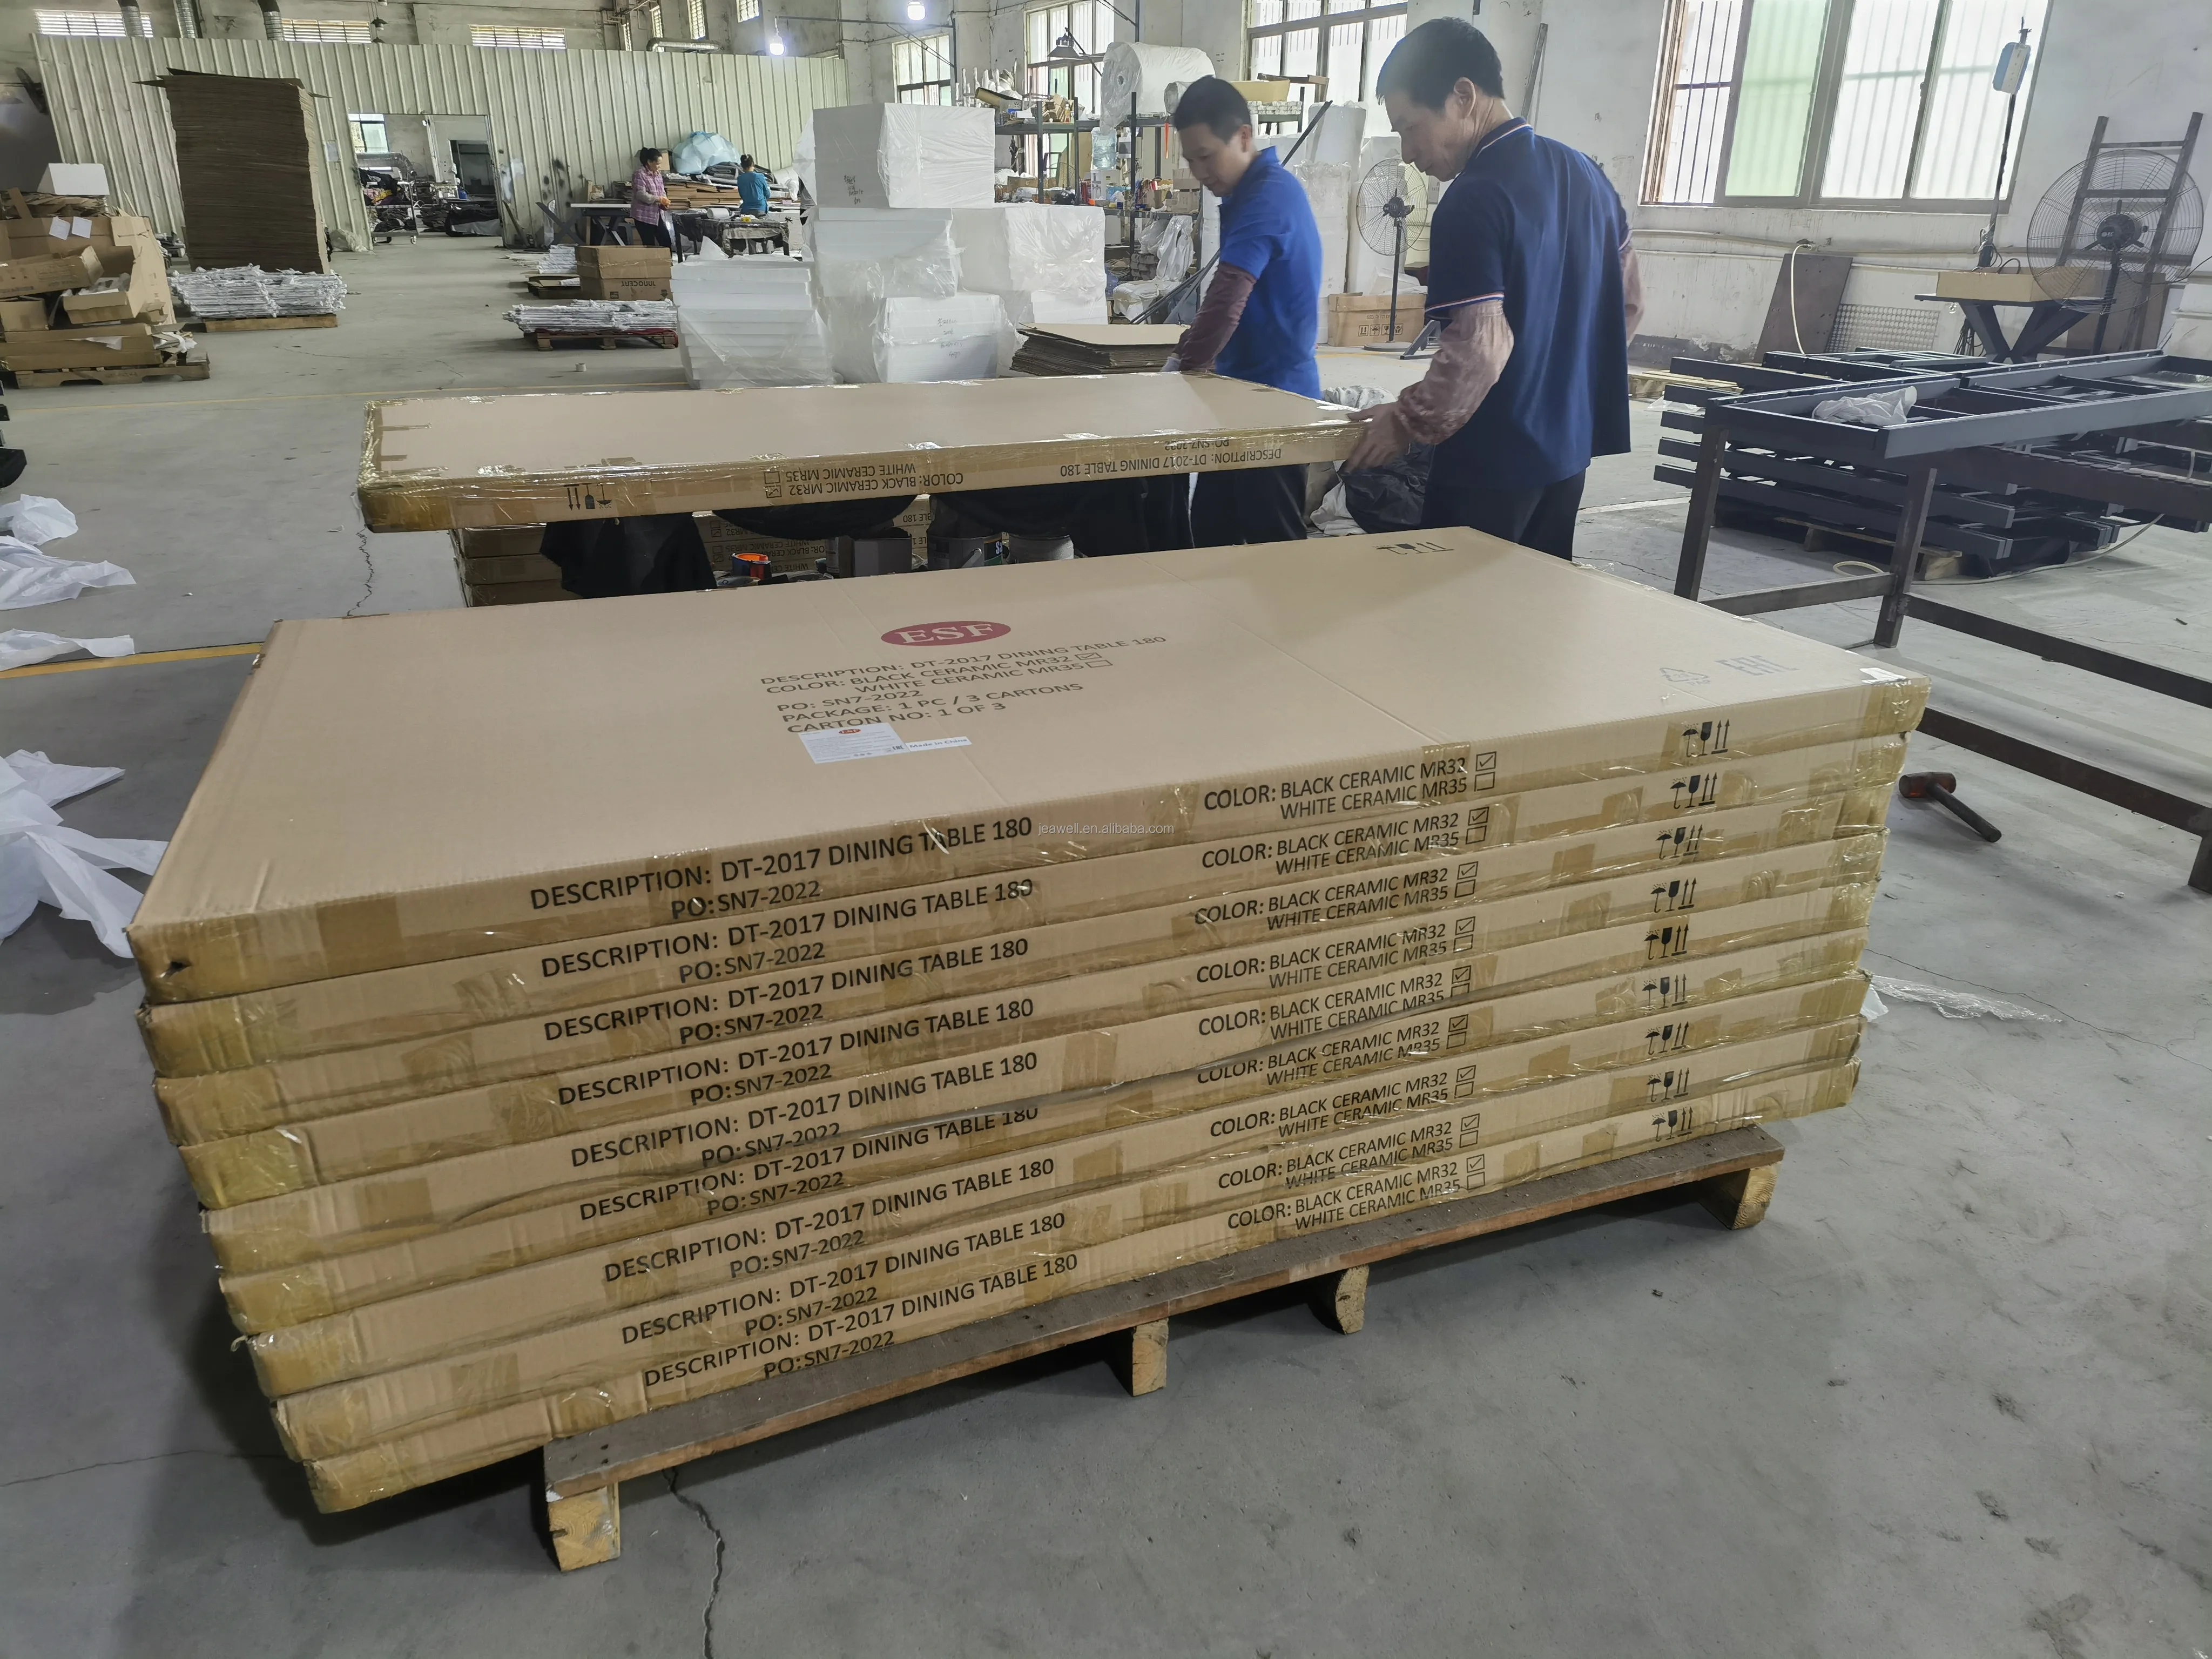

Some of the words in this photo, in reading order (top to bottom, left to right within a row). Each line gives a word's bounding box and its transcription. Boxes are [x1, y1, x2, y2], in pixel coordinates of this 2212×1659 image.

[786, 469, 819, 482] MR35
[823, 466, 875, 480] CERAMIC
[879, 463, 916, 475] WHITE
[1060, 463, 1081, 477] 180
[1084, 461, 1117, 475] TABLE
[1121, 457, 1159, 472] DINING
[1163, 454, 1206, 468] DT-2017
[1211, 448, 1281, 464] DESCRIPTION:
[790, 483, 822, 496] MR32
[826, 479, 878, 494] CERAMIC
[882, 476, 916, 489] BLACK
[919, 473, 963, 486] COLOR:
[903, 515, 917, 523] 180
[919, 512, 932, 521] BLE
[750, 542, 783, 550] CERAMIC
[894, 623, 994, 644] ESF
[761, 665, 903, 684] DESCRIPTION:
[910, 655, 992, 669] DT-2017
[997, 648, 1069, 660] DINING
[1070, 640, 1129, 651] TABLE
[1131, 637, 1166, 645] 180
[766, 680, 845, 693] COLOR:
[850, 672, 915, 686] BLACK
[920, 663, 1011, 677] CERAMIC
[1015, 656, 1073, 667] MR32
[854, 679, 926, 693] WHITE
[931, 670, 1024, 685] CERAMIC
[1027, 663, 1084, 675] MR35
[777, 702, 816, 712] PO:
[822, 690, 923, 707] SN7-2022
[782, 705, 890, 723] PACKAGE:
[918, 698, 947, 707] PC
[953, 696, 959, 705] /
[986, 684, 1084, 699] CARTONS
[787, 716, 883, 733] CARTON
[889, 711, 932, 722] NO:
[938, 709, 952, 717] 1
[957, 705, 986, 714] OF
[993, 703, 1007, 711] 3
[1204, 785, 1276, 810] COLOR:
[1281, 776, 1334, 799] BLACK
[1339, 765, 1414, 790] CERAMIC
[1420, 757, 1466, 779] MR32
[1280, 797, 1336, 820] WHITE
[1342, 785, 1417, 811] CERAMIC
[1421, 777, 1467, 799] MR35
[1202, 843, 1272, 868] COLOR:
[1277, 833, 1329, 855] BLACK
[1334, 820, 1408, 846] CERAMIC
[1413, 813, 1458, 834] MR32
[1276, 852, 1330, 875] WHITE
[1336, 839, 1408, 865] CERAMIC
[531, 866, 711, 909] DESCRIPTION:
[721, 848, 820, 882] DT-2017
[829, 834, 912, 865] DINING
[919, 824, 986, 851] TABLE
[993, 817, 1031, 840] 180
[672, 880, 820, 919] PO:SN7-2022
[1267, 908, 1321, 930] WHITE
[1326, 894, 1399, 919] CERAMIC
[1404, 885, 1448, 907] MR35
[1269, 889, 1319, 912] BLACK
[1325, 876, 1399, 901] CERAMIC
[1403, 867, 1448, 889] MR32
[542, 932, 717, 977] DESCRIPTION:
[729, 913, 825, 946] DT-2017
[834, 899, 916, 928] DINING
[922, 887, 988, 913] TABLE
[680, 942, 825, 983] PO:SN7-2022
[1197, 957, 1265, 983] COLOR:
[1270, 948, 1320, 970] BLACK
[1325, 933, 1397, 959] CERAMIC
[1269, 966, 1322, 989] WHITE
[1327, 951, 1398, 977] CERAMIC
[1404, 941, 1447, 962] MR35
[544, 995, 718, 1041] DESCRIPTION:
[729, 975, 824, 1008] DT-2017
[832, 959, 912, 989] DINING
[919, 947, 983, 973] TABLE
[990, 938, 1028, 960] 180
[1199, 1009, 1266, 1035] COLOR:
[1270, 999, 1320, 1021] BLACK
[1325, 982, 1395, 1009] CERAMIC
[1400, 973, 1442, 994] MR32
[680, 1003, 823, 1044] PO:SN7-2022
[558, 1057, 729, 1105] DESCRIPTION:
[738, 1036, 832, 1069] DT-2017
[840, 1020, 919, 1050] DINING
[925, 1007, 989, 1033] TABLE
[996, 999, 1034, 1022] 180
[1267, 1047, 1317, 1069] BLACK
[1322, 1031, 1392, 1057] CERAMIC
[1397, 1022, 1439, 1042] MR32
[691, 1064, 832, 1105] PO:SN7-2022
[1210, 1111, 1275, 1137] COLOR:
[1279, 1099, 1327, 1121] BLACK
[1332, 1082, 1401, 1109] CERAMIC
[1405, 1072, 1448, 1094] MR32
[571, 1116, 739, 1167] DESCRIPTION:
[748, 1094, 840, 1129] DT-2017
[848, 1076, 926, 1108] DINING
[931, 1061, 994, 1090] TABLE
[1000, 1052, 1037, 1076] 180
[580, 1170, 744, 1220] DESCRIPTION:
[754, 1146, 845, 1181] DT-2017
[853, 1129, 929, 1159] DINING
[934, 1114, 995, 1140] TABLE
[1218, 1162, 1283, 1189] COLOR:
[1286, 1150, 1334, 1173] BLACK
[1339, 1132, 1406, 1160] CERAMIC
[1410, 1121, 1452, 1143] MR32
[707, 1171, 844, 1216] PO:SN7-2022
[775, 1203, 865, 1239] DT-2017
[873, 1184, 947, 1216] DINING
[952, 1168, 1013, 1196] TABLE
[1019, 1158, 1054, 1181] 180
[1228, 1203, 1292, 1229] COLOR:
[1296, 1189, 1342, 1213] BLACK
[1347, 1172, 1413, 1201] CERAMIC
[1417, 1162, 1458, 1183] MR32
[1295, 1208, 1344, 1230] WHITE
[1350, 1189, 1414, 1217] CERAMIC
[730, 1230, 865, 1278] PO:SN7-2022
[622, 1288, 781, 1344] DESCRIPTION:
[790, 1260, 878, 1298] DT-2017
[885, 1240, 959, 1273] DINING
[964, 1223, 1024, 1252] TABLE
[1030, 1212, 1065, 1235] 180
[645, 1332, 799, 1387] DESCRIPTION:
[808, 1304, 895, 1341] DT-2017
[902, 1283, 975, 1317] DINING
[979, 1265, 1037, 1294] TABLE
[1043, 1253, 1077, 1277] 180
[764, 1331, 894, 1379] PO:SN7-2022
